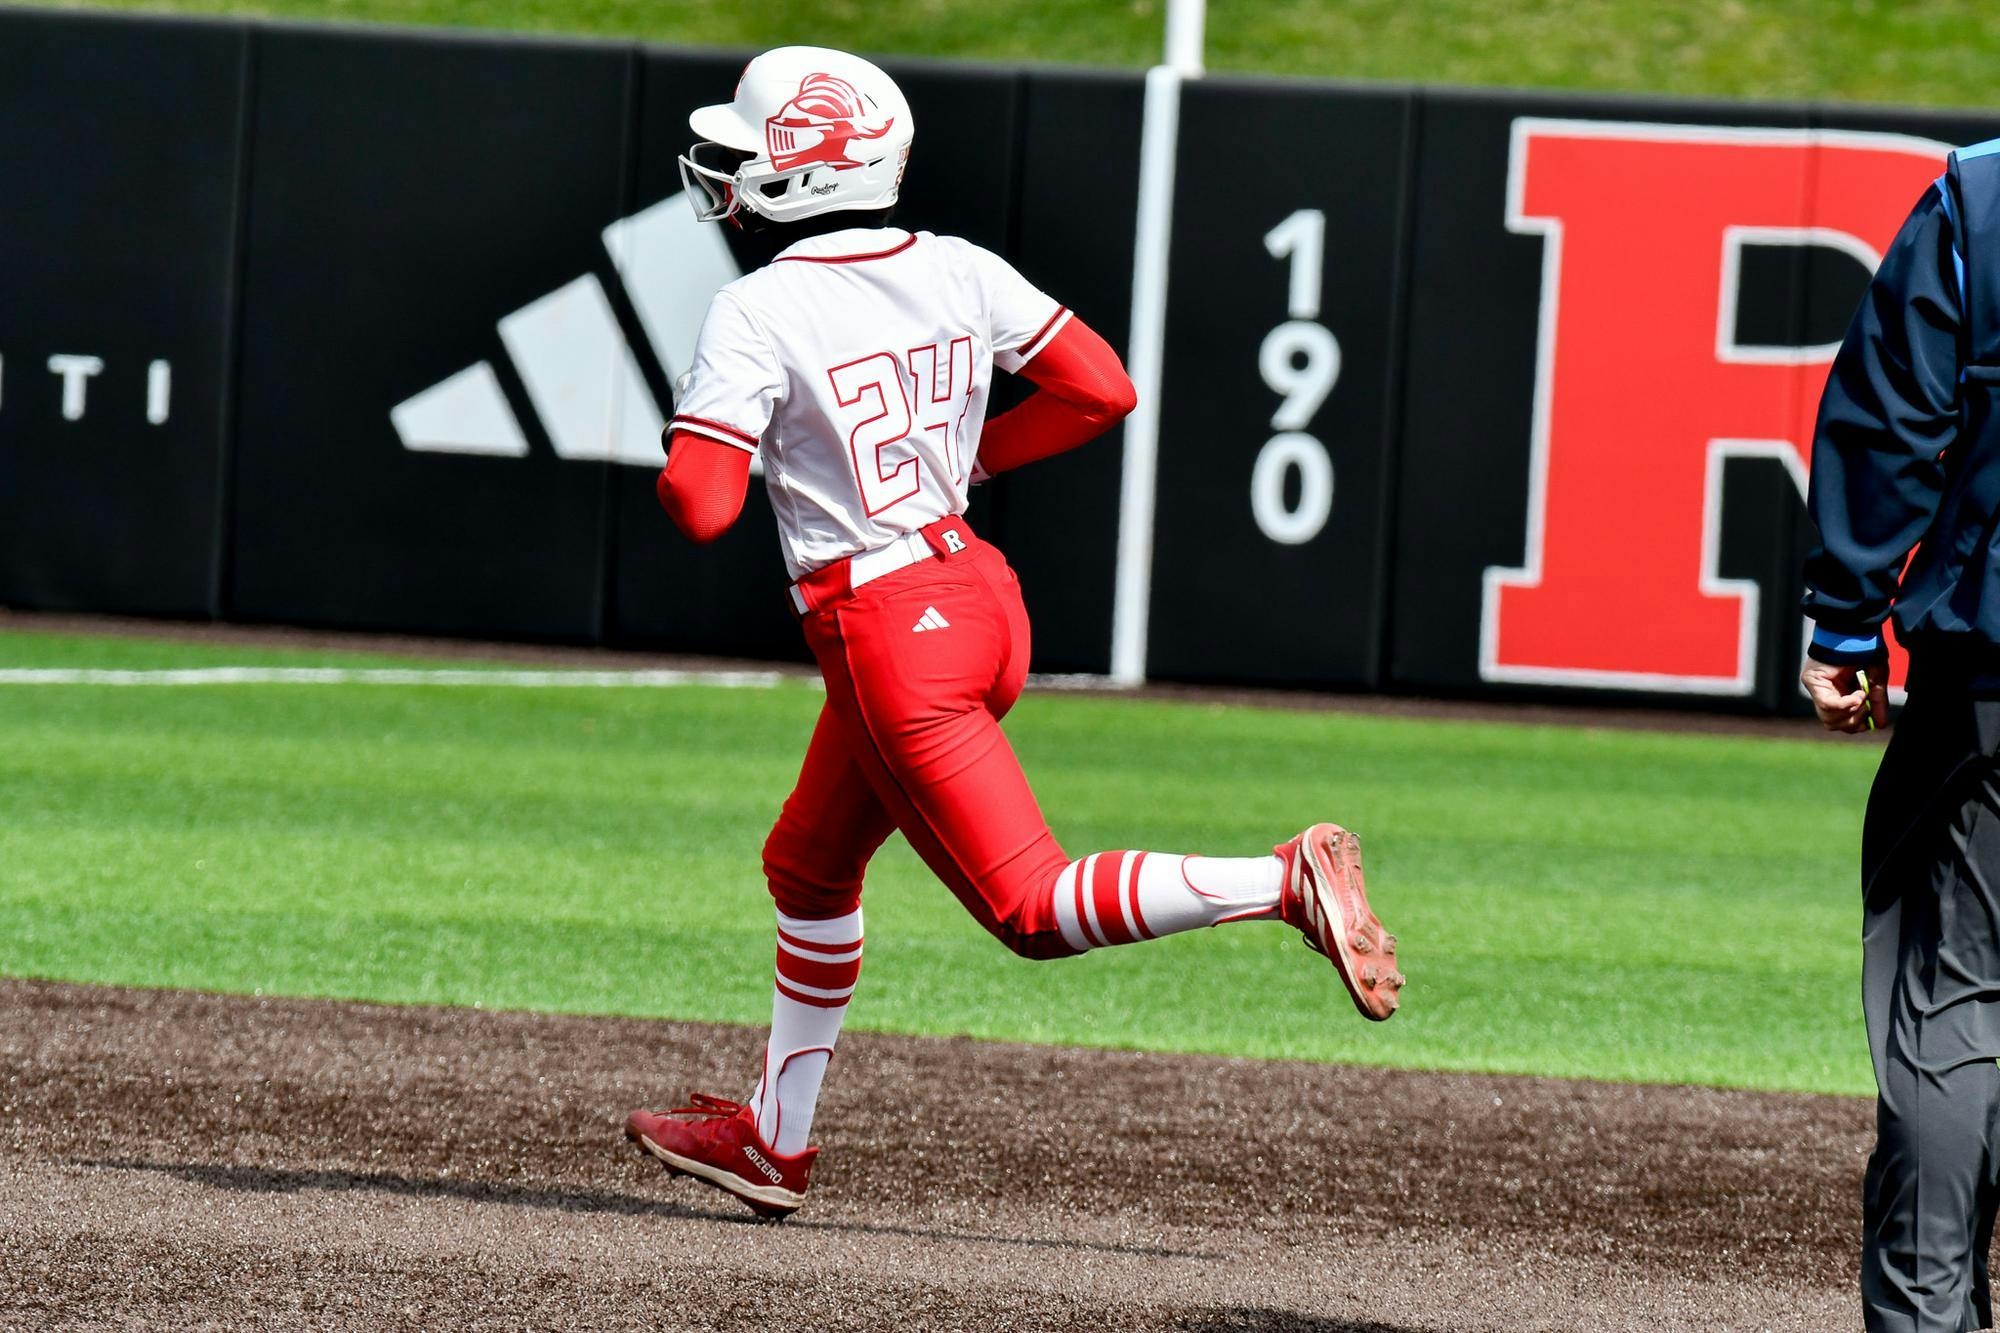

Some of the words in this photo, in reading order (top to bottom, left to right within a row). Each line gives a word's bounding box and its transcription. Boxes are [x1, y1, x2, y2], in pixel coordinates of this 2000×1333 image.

[0, 353, 171, 426] TI
[827, 335, 973, 519] 24
[1250, 208, 1342, 545] 190
[1477, 116, 1960, 704] R
[940, 529, 968, 554] R
[742, 1145, 783, 1184] ADIZERO
